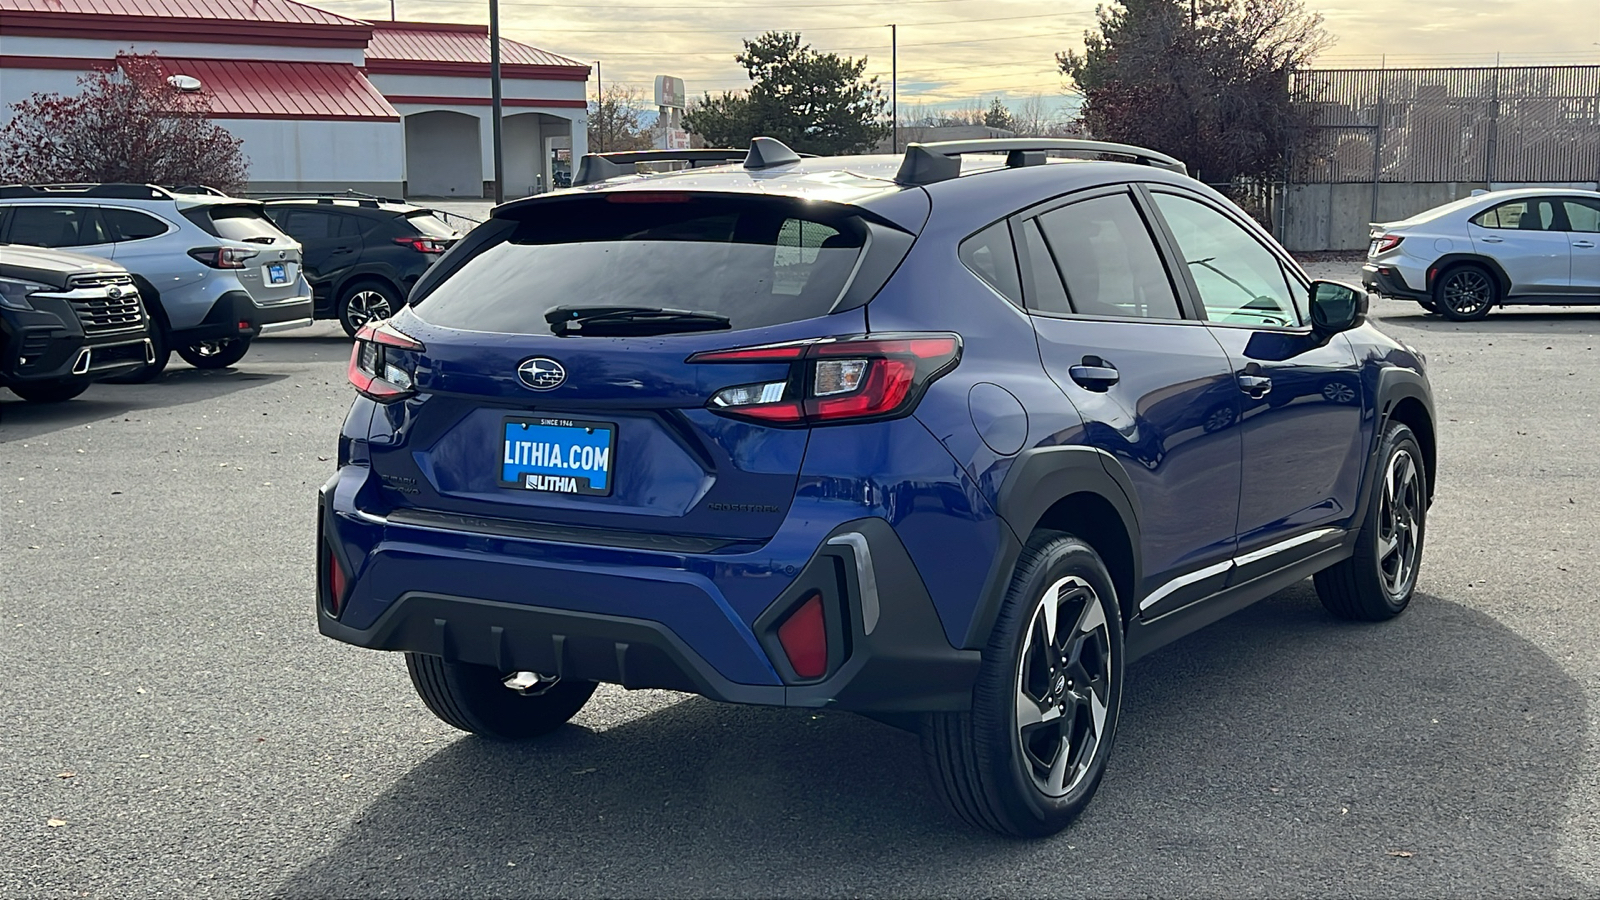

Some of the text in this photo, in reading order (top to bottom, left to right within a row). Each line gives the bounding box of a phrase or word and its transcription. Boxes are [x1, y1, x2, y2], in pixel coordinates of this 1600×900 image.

[504, 440, 609, 472] LITHIA.COM
[537, 475, 577, 493] LITHIA
[706, 502, 780, 513] CROSSTREK
